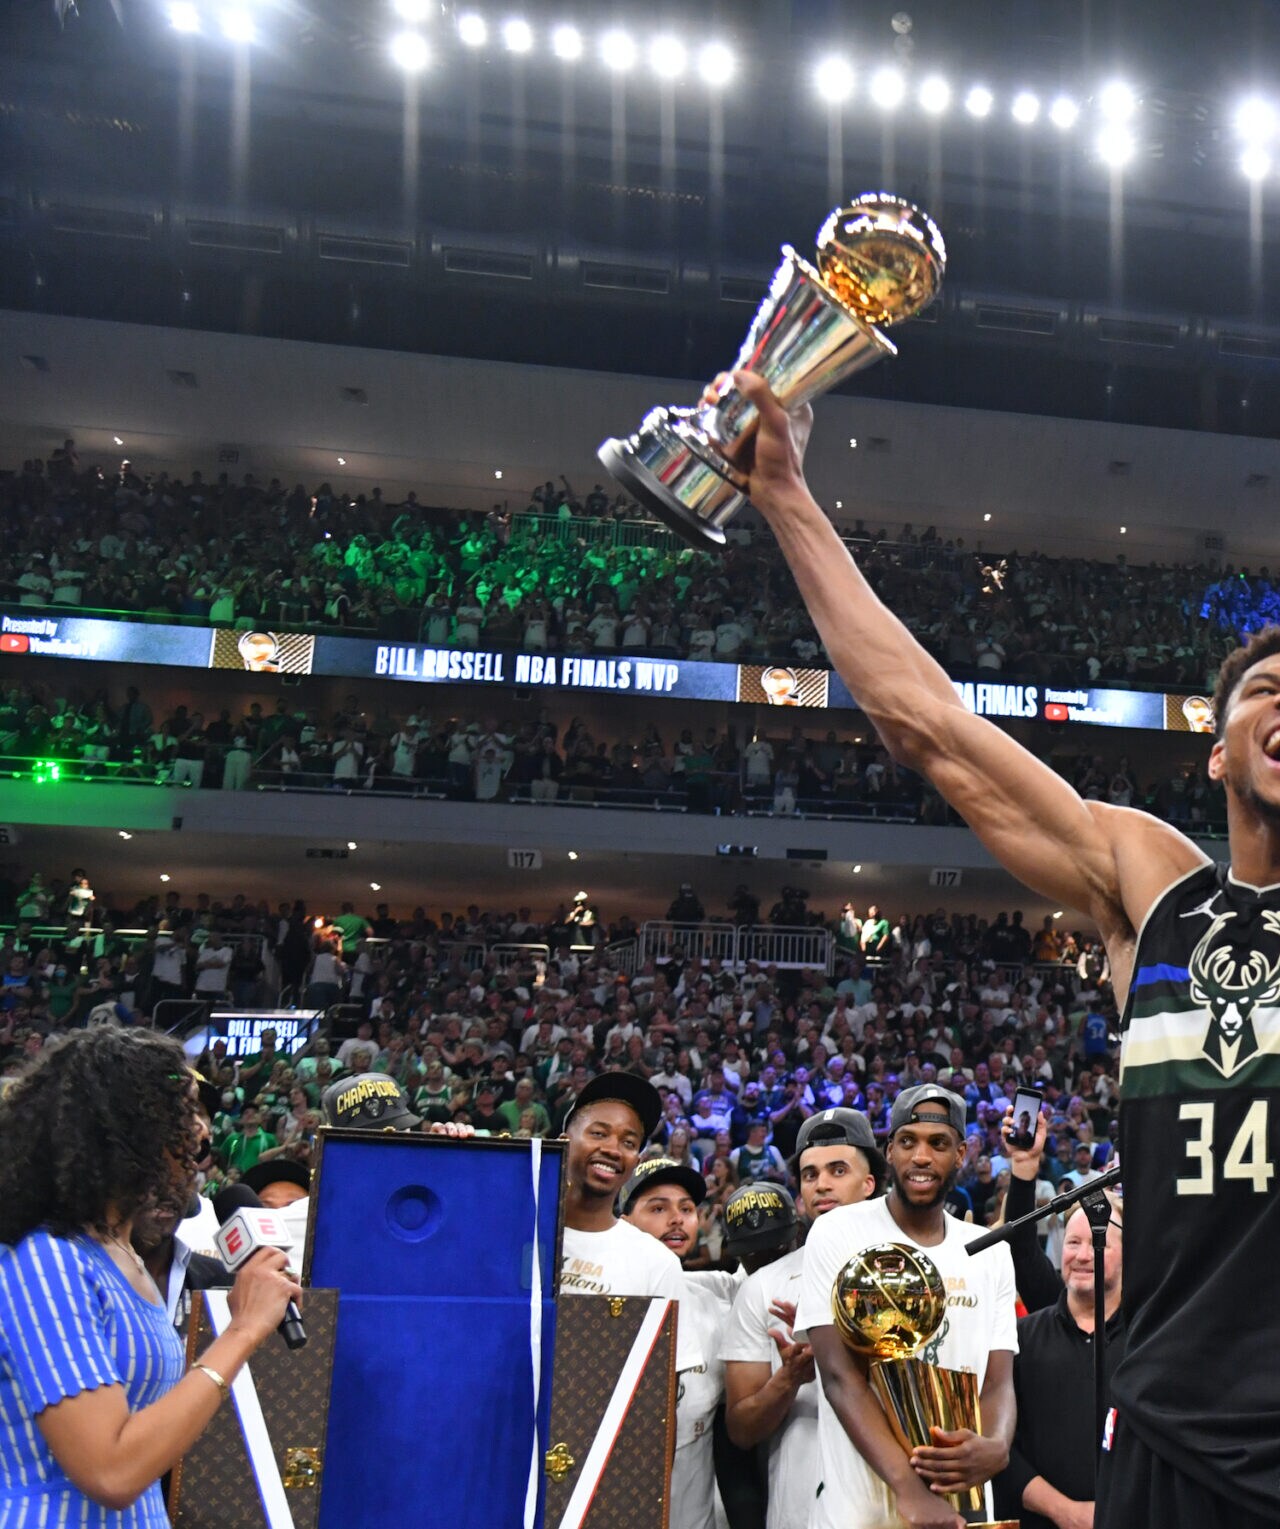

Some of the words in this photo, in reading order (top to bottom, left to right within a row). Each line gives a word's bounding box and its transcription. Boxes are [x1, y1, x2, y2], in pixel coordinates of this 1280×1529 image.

[2, 616, 46, 635] Presented
[375, 646, 418, 676] BILL
[422, 649, 504, 681] RUSSELL
[515, 655, 556, 684] NBA
[562, 658, 631, 689] FINALS
[634, 662, 679, 691] MVP
[977, 684, 1038, 718] FINALS
[513, 852, 535, 867] 117
[935, 871, 957, 887] 117
[228, 1020, 252, 1036] BILL
[337, 1080, 400, 1115] CHAMPIONS
[1176, 1100, 1275, 1196] 34
[726, 1193, 783, 1224] CHAMPIONS
[571, 1259, 603, 1278] NBA
